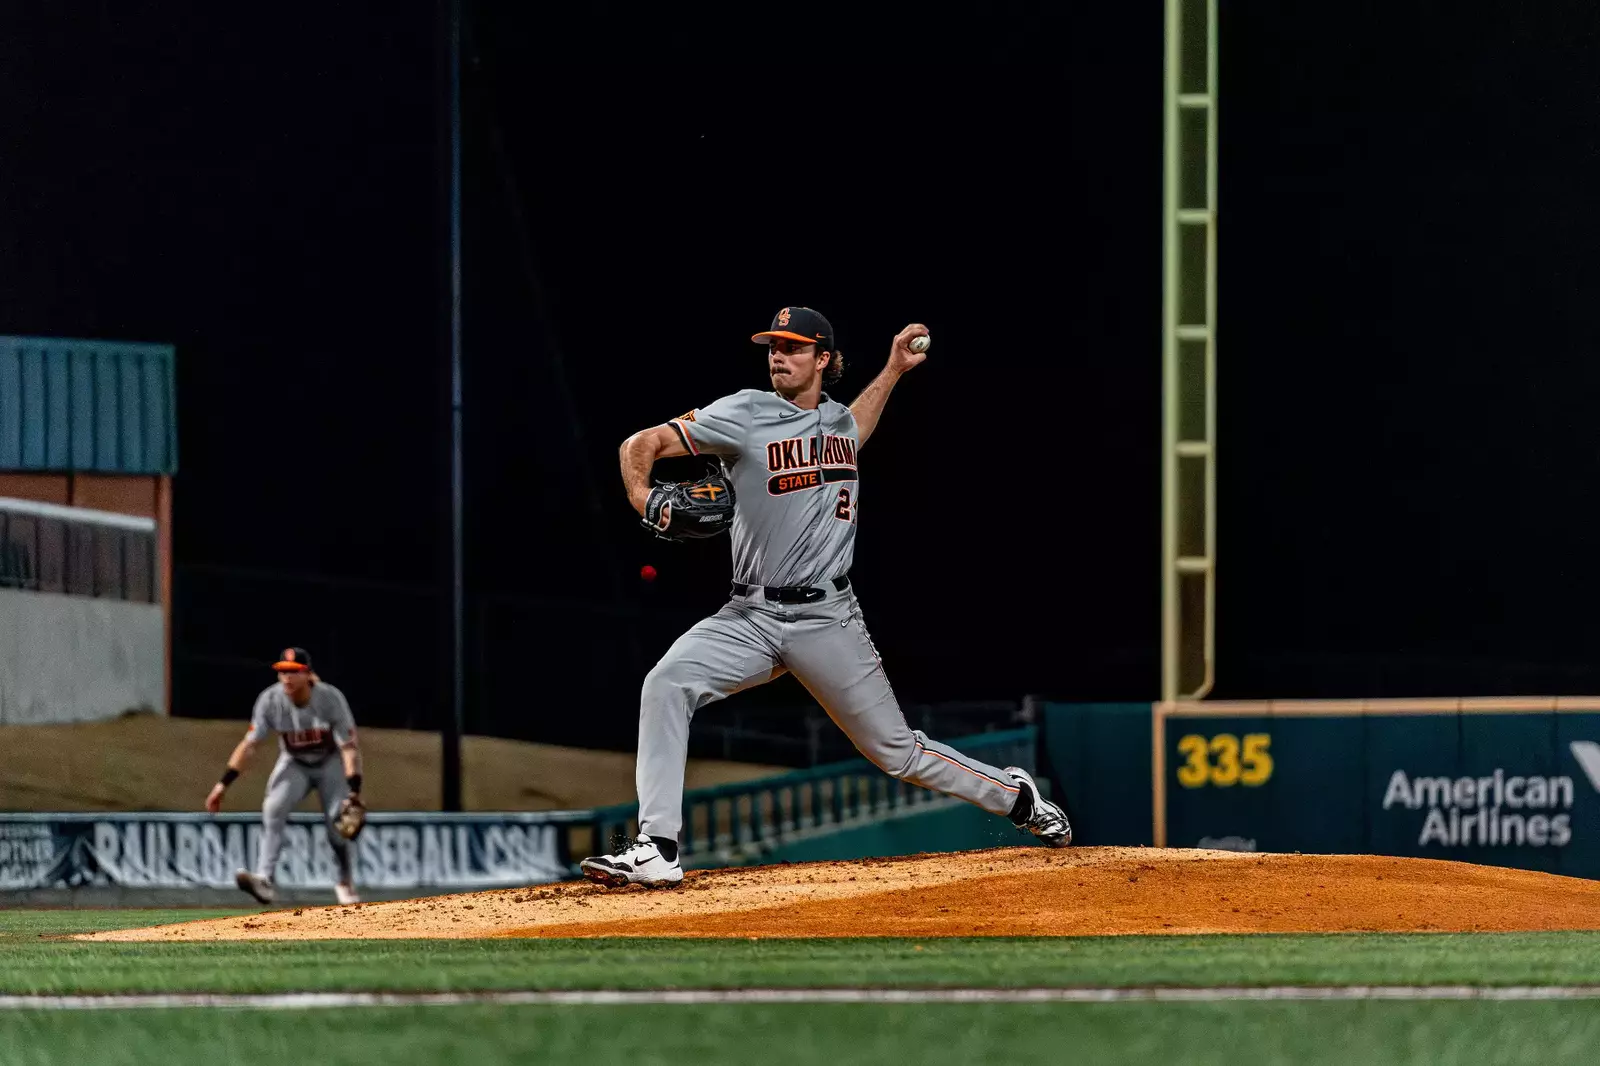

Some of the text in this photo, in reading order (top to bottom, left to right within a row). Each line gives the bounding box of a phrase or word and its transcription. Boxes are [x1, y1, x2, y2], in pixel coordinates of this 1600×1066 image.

[778, 473, 817, 490] STATE
[834, 487, 857, 524] 2
[1177, 733, 1274, 788] 335
[1382, 768, 1574, 810] American
[1418, 807, 1572, 847] Airlines
